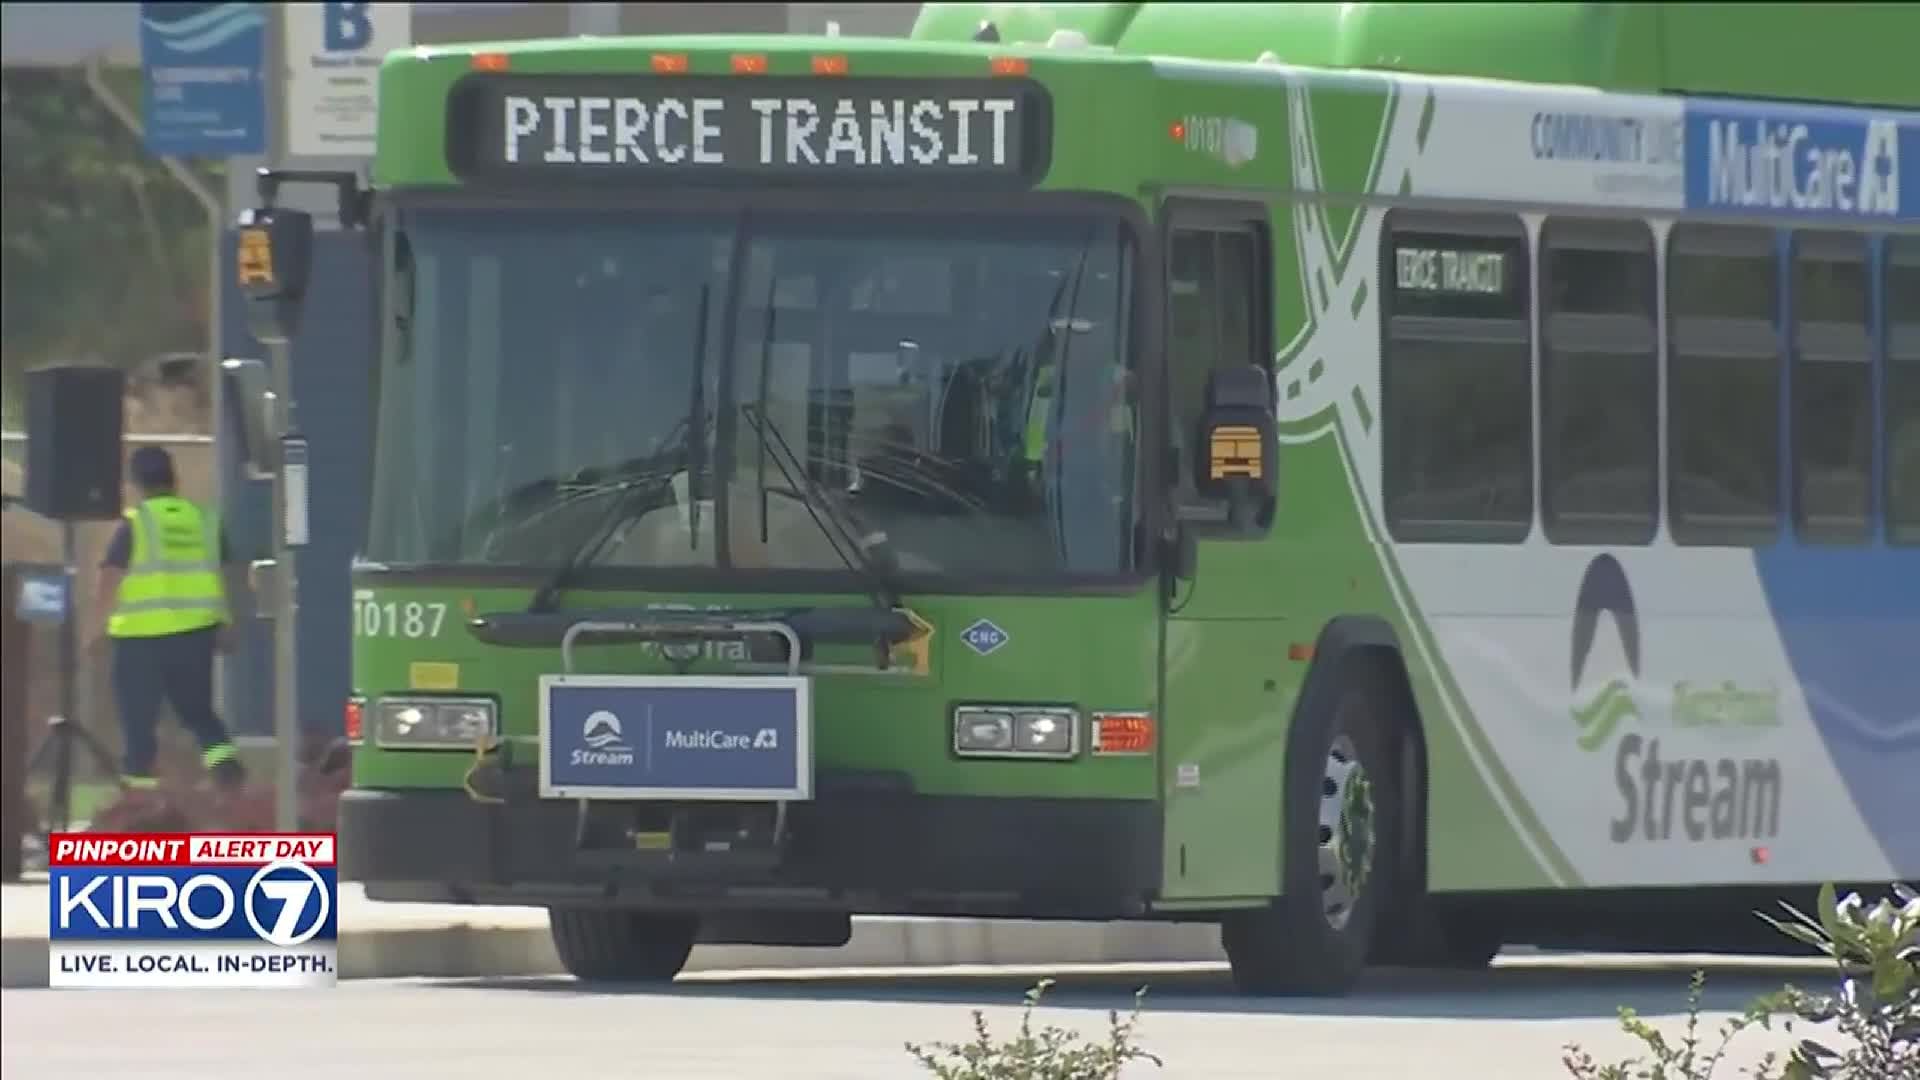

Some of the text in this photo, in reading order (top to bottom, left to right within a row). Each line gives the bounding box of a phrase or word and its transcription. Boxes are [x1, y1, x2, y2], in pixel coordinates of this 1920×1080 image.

[503, 96, 1016, 166] PIERCE TRANSIT
[1707, 118, 1856, 211] MultiCare
[353, 602, 447, 638] 10187
[968, 630, 999, 644] CNG
[570, 748, 634, 766] Stream
[664, 729, 750, 750] MultiCare
[1610, 732, 1782, 844] Stream
